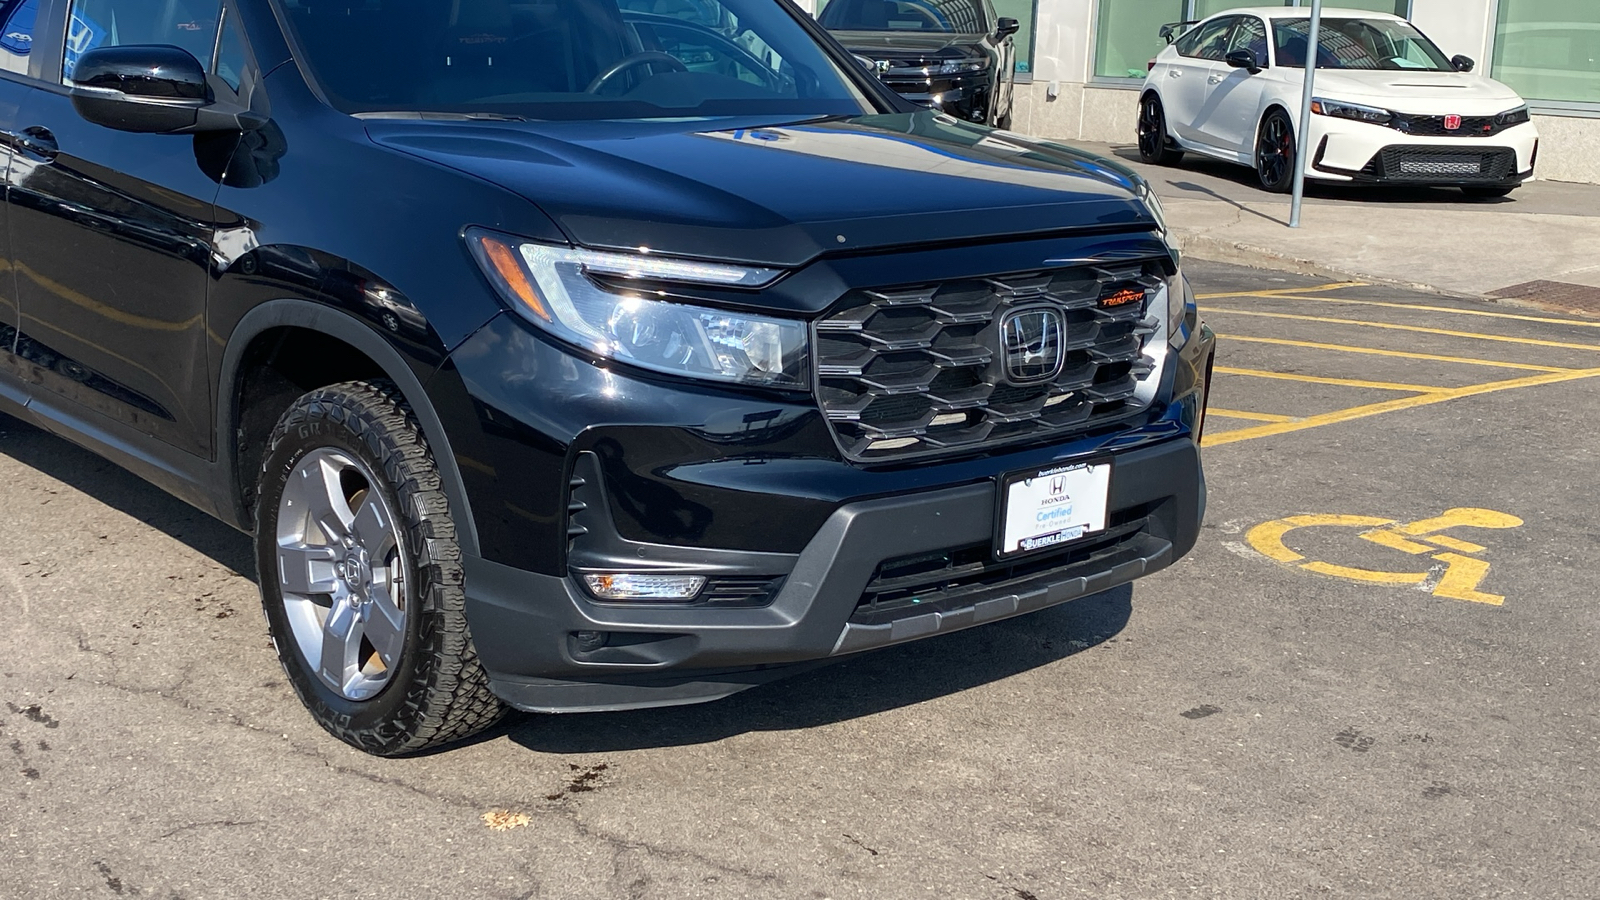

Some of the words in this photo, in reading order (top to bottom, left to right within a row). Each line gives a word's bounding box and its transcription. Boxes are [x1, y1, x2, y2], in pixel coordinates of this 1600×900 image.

[1041, 494, 1071, 506] HONDA
[1036, 505, 1072, 522] Certified
[1035, 517, 1072, 530] Pre-Owned
